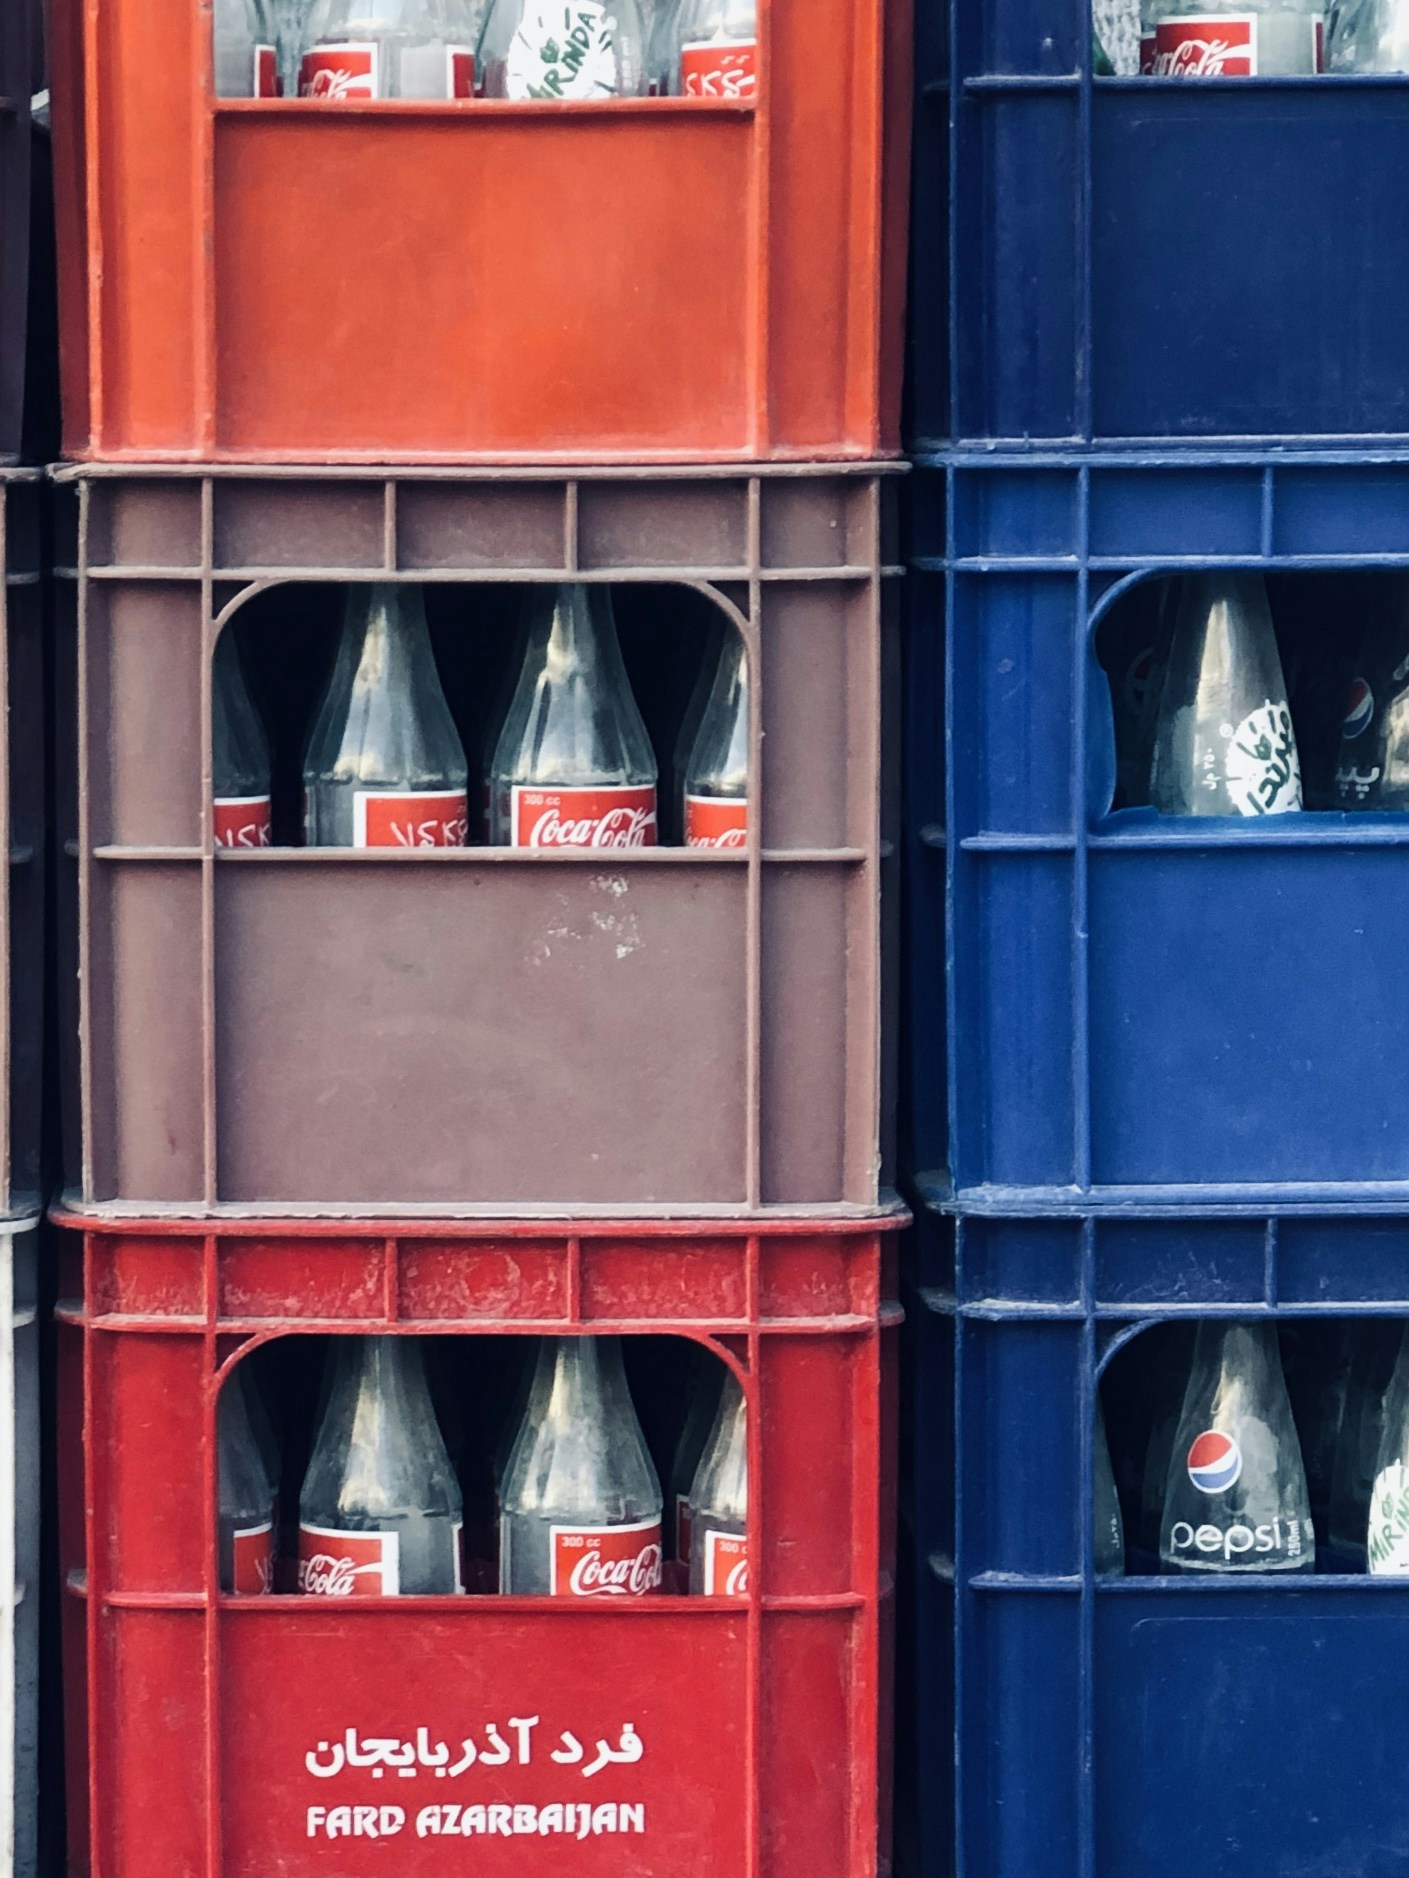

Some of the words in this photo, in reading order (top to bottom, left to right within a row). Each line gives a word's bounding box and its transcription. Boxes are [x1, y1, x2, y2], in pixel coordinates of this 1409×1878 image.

[546, 795, 562, 806] cc
[562, 1536, 585, 1548] 300
[586, 1537, 602, 1548] cc
[719, 1541, 739, 1553] 300
[1171, 1516, 1282, 1560] pepsi
[1287, 1519, 1302, 1557] 250ml
[569, 1544, 663, 1596] Coca-Col
[305, 1715, 540, 1779] آذربایجان
[549, 1721, 645, 1778] فرد
[305, 1804, 406, 1840] FARD
[415, 1802, 646, 1842] AZARBAIJAN
